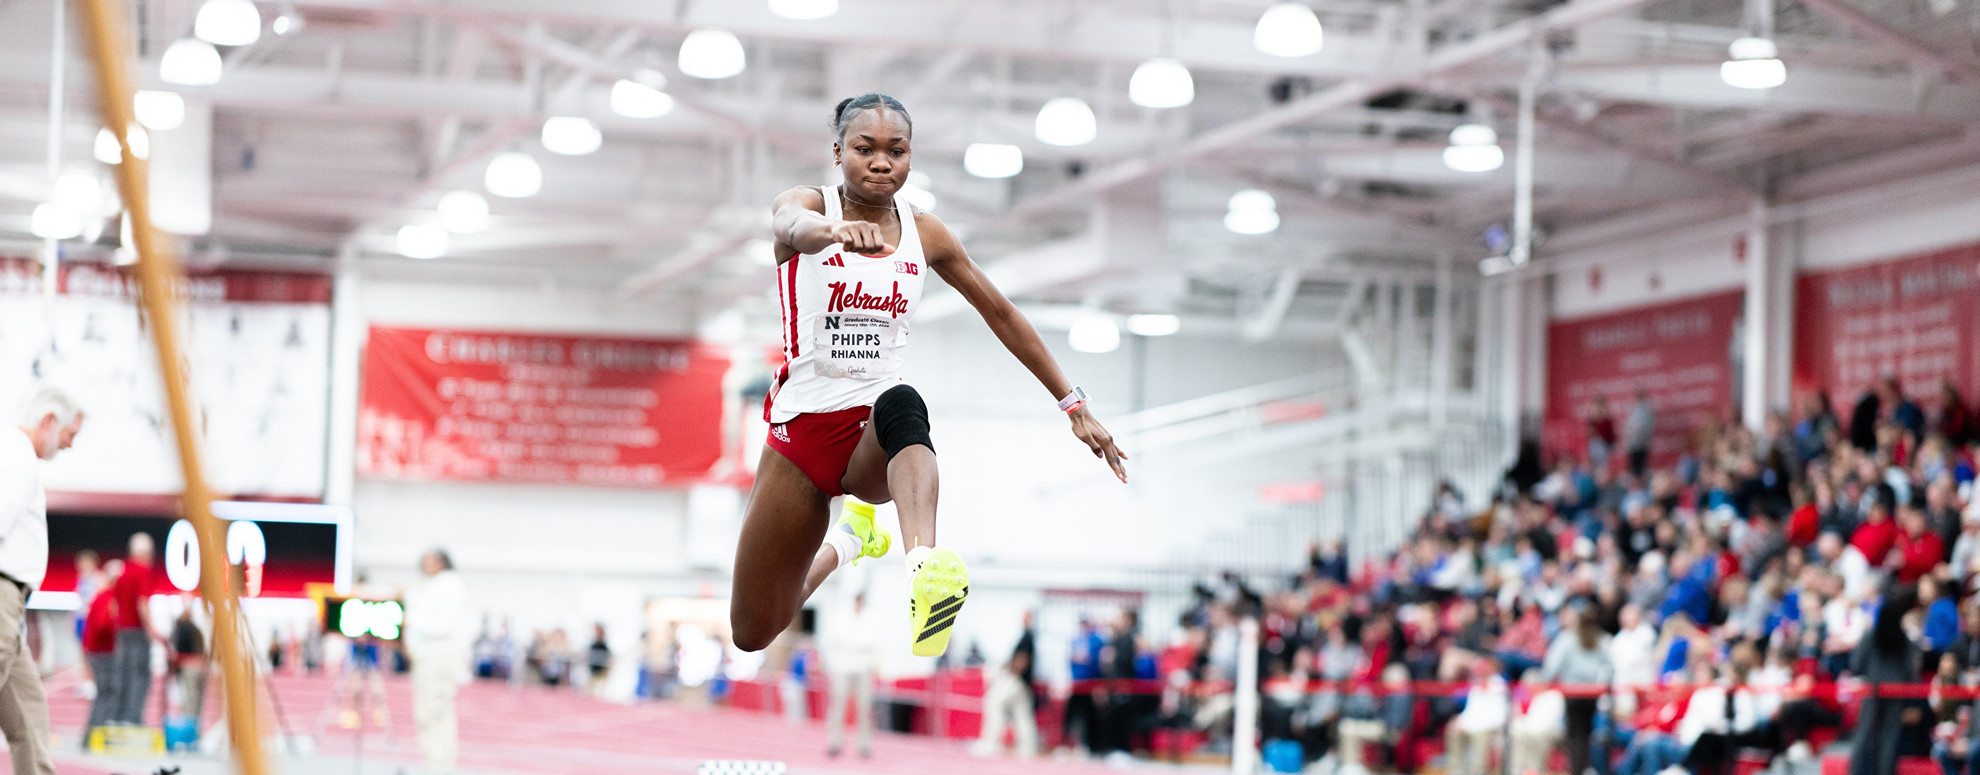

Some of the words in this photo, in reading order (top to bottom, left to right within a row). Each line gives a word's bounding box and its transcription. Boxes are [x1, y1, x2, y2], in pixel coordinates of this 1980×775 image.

[827, 280, 909, 319] Nebraska
[825, 316, 840, 329] N
[832, 334, 880, 346] PHIPPS
[831, 350, 880, 359] RHIANNA
[771, 428, 791, 443] adidas
